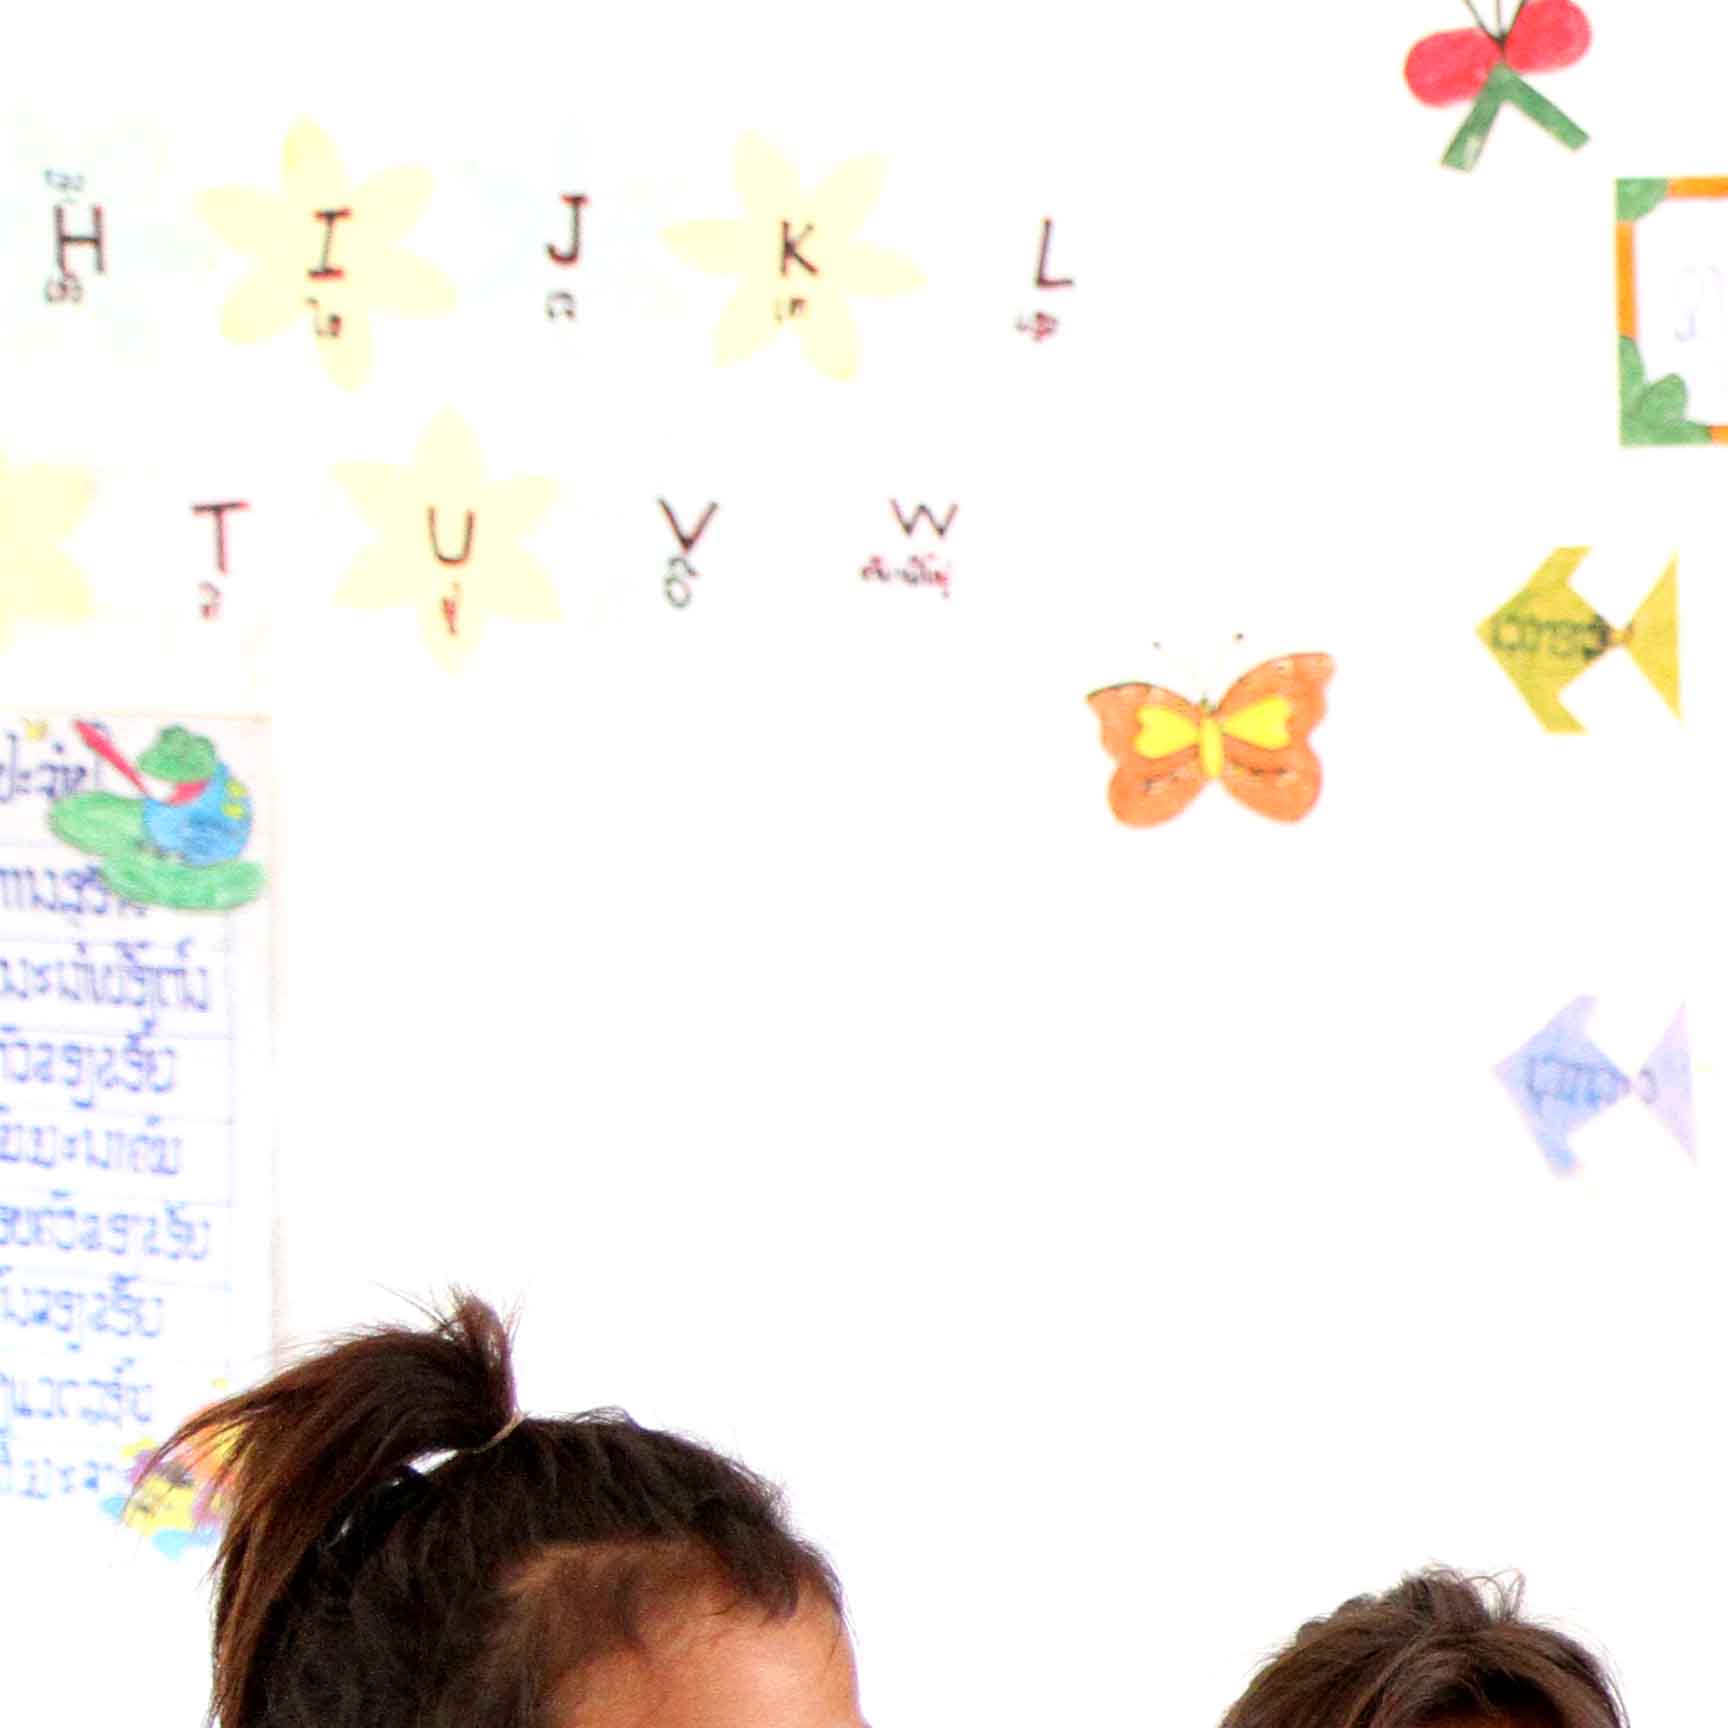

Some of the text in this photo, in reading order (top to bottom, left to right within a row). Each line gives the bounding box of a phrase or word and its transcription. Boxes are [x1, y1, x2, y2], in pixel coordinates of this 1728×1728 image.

[55, 194, 1073, 289] H I J K L
[192, 498, 959, 573] T U V W
